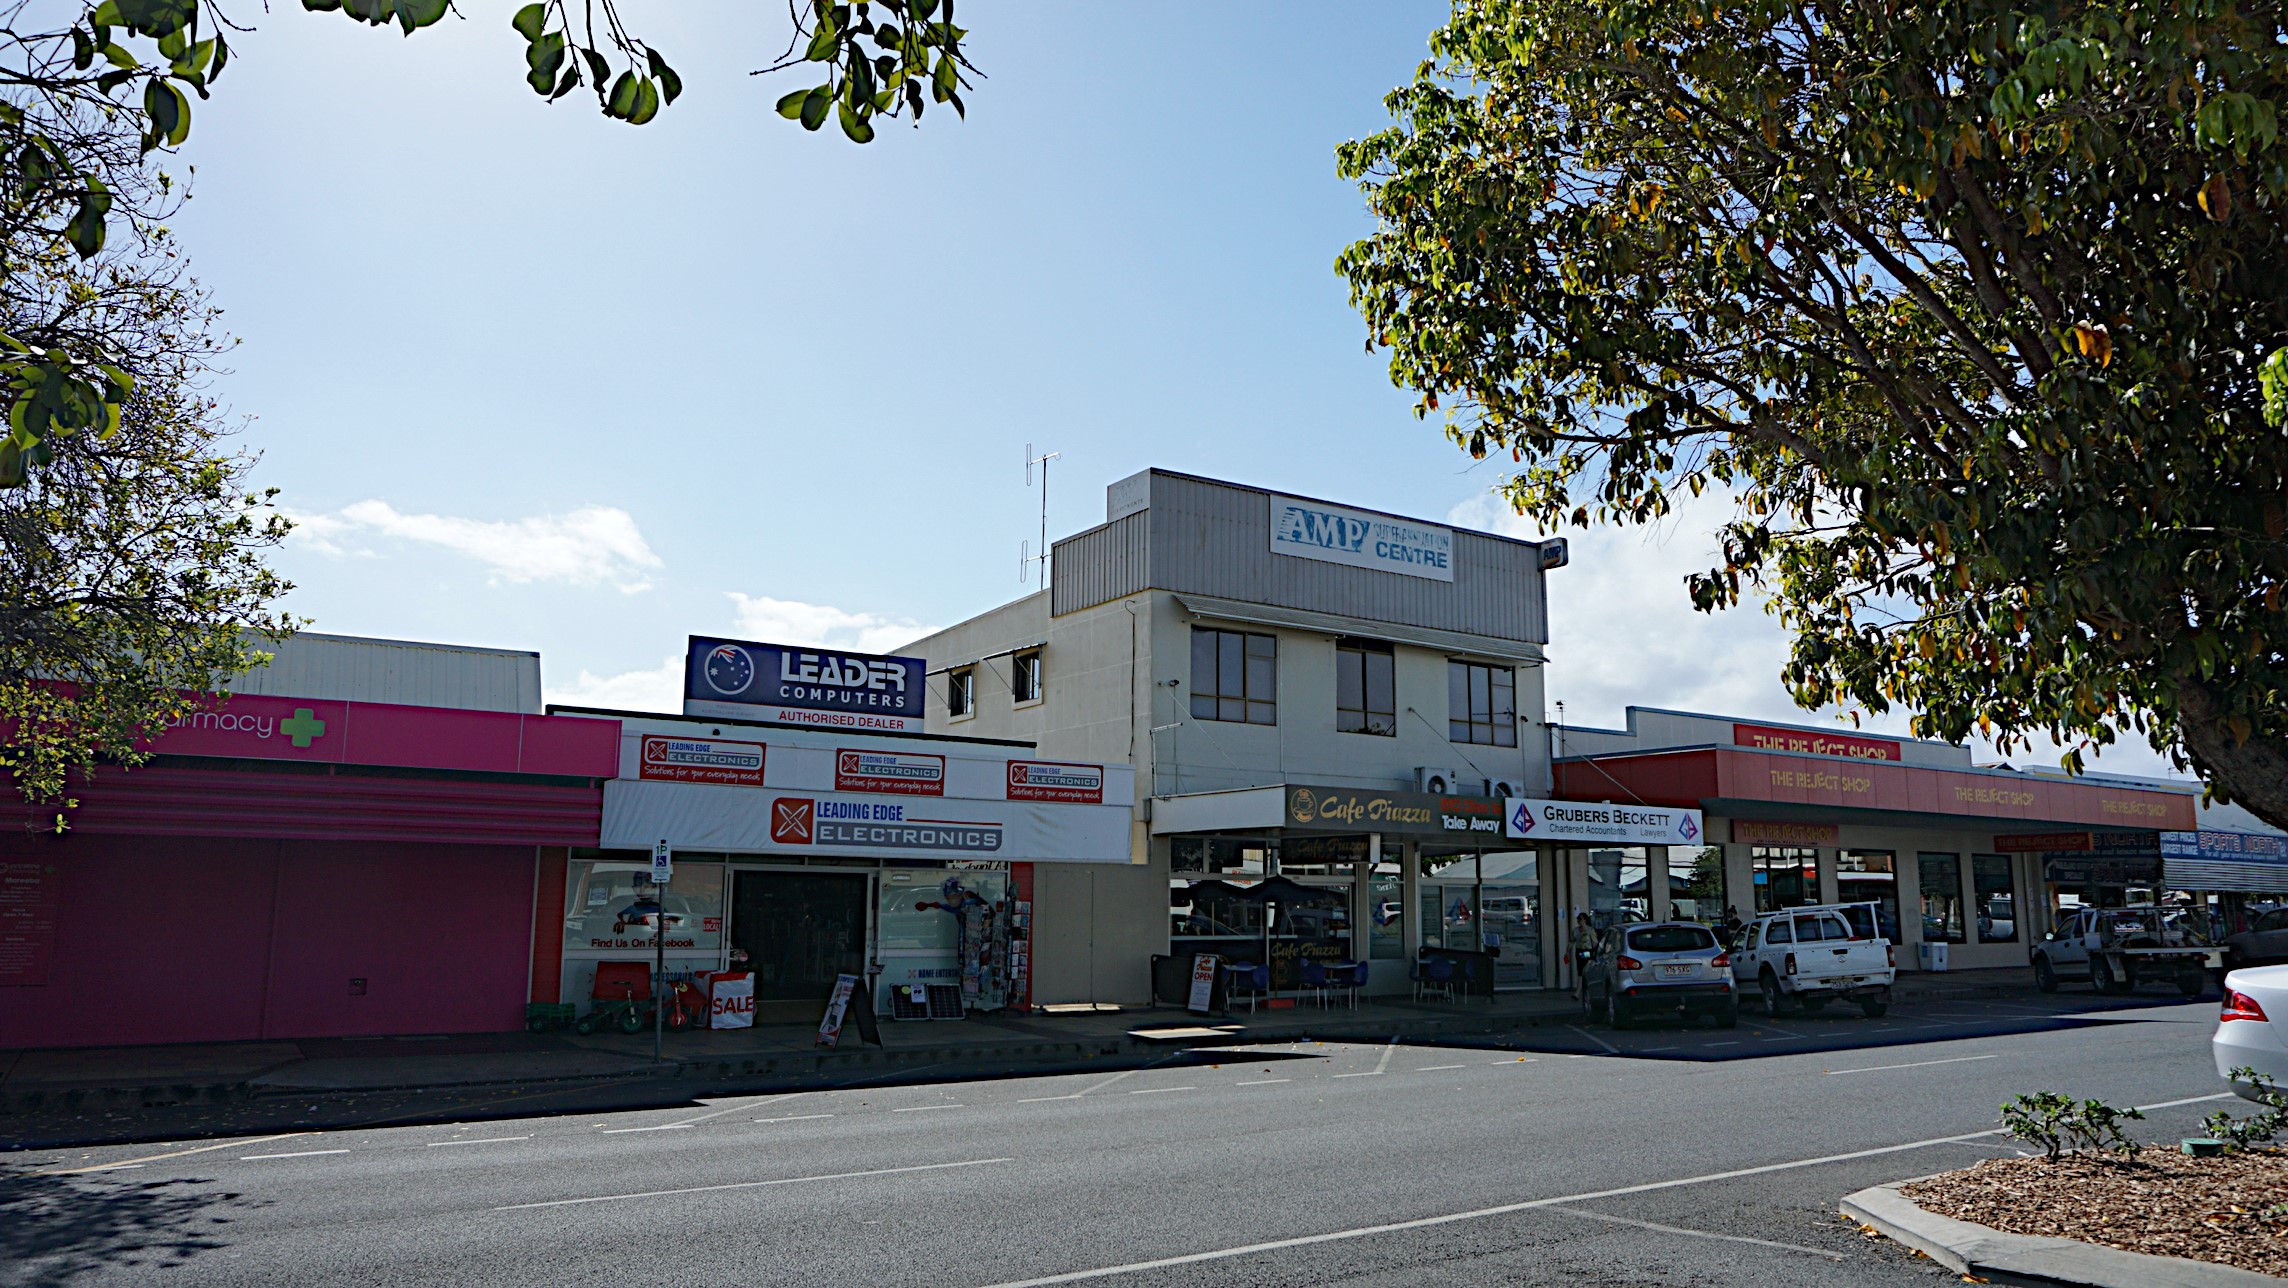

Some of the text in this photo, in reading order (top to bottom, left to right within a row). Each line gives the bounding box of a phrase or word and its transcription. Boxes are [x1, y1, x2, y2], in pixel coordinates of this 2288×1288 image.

[1288, 508, 1365, 549] AMP
[1376, 541, 1447, 569] CENTRE
[1544, 546, 1561, 560] AMP
[781, 652, 906, 692] LEADER
[780, 686, 905, 708] COMPUTERS
[779, 711, 904, 730] AUTHORISED DEALER
[668, 742, 694, 752] LEADING
[1754, 735, 1784, 750] THE
[669, 753, 758, 765] ELECTRONICS
[860, 755, 897, 765] LEADING EDGE
[644, 765, 674, 776] Solutions
[676, 767, 689, 778] for
[691, 770, 704, 780] your
[706, 770, 738, 783] everyday
[860, 765, 938, 777] ELECTRONICS
[1028, 766, 1047, 774] LEADING
[839, 776, 865, 788] Solutions
[867, 778, 878, 790] for
[879, 780, 893, 791] your
[894, 781, 921, 793] everyday
[1029, 776, 1098, 786] ELECTRONICS
[1770, 770, 1871, 793] THE REJECT SHOP
[1010, 786, 1034, 797] Solutions
[1035, 787, 1045, 798] for
[1058, 790, 1083, 801] everyday
[1954, 786, 2035, 807] THE REJECT SHOP
[816, 801, 904, 822] LEADING EDGE
[1320, 795, 1364, 824] Cafe
[1367, 799, 1431, 824] Piazza
[1543, 805, 1671, 827] GRUBERS BECKETT
[2102, 799, 2168, 817] THE REJECT SHOP
[1441, 814, 1501, 834] Take Away
[1550, 823, 1668, 838] Chartered Accountants Lawyers
[1743, 823, 1832, 841] THE REJECT SHOP
[819, 825, 998, 847] ELECTRONICS
[2198, 831, 2241, 852] SPORTS
[2244, 834, 2280, 854] NORTH
[656, 845, 667, 855] 1P
[591, 938, 695, 948] Find Us On Faebook
[1271, 942, 1342, 959] Cafe Piazza
[918, 969, 934, 978] HOME
[1195, 971, 1213, 981] OPEN
[712, 995, 754, 1015] SALE
